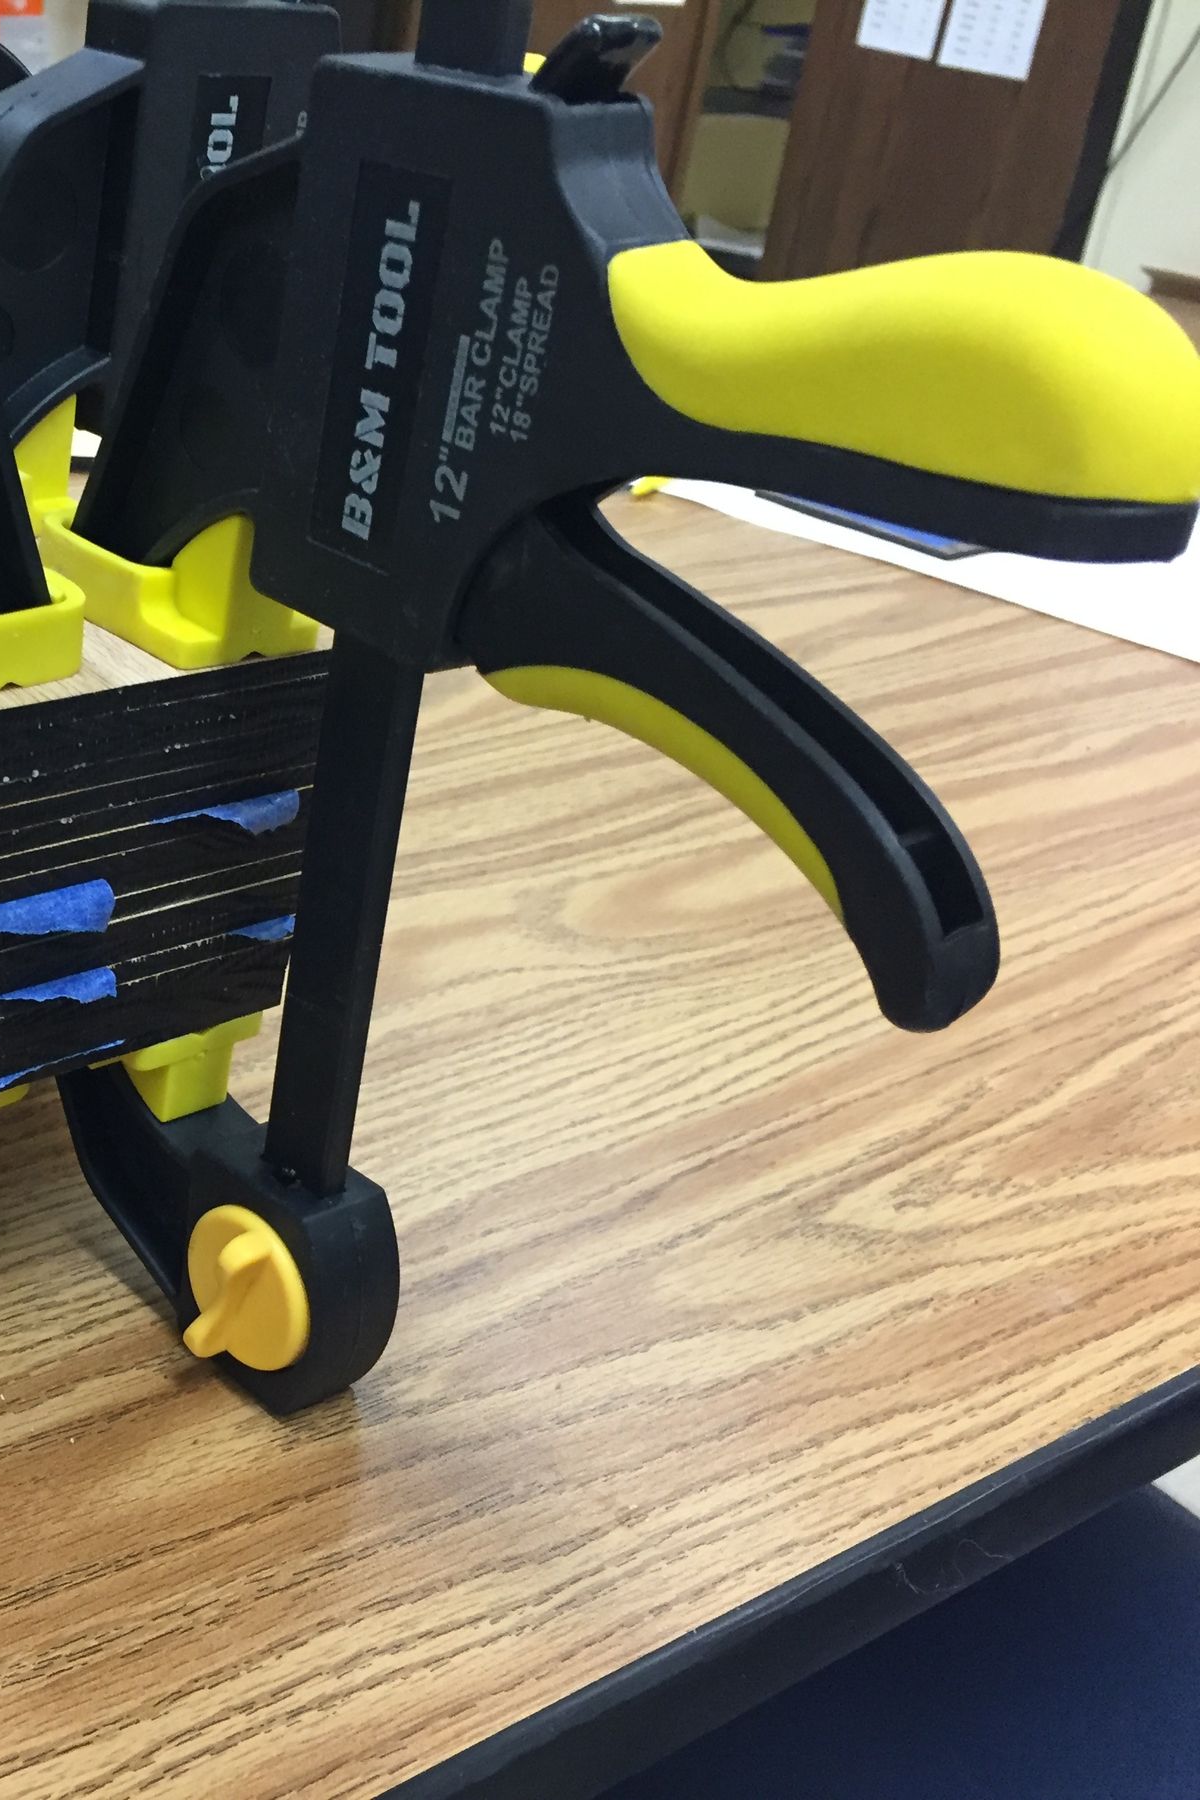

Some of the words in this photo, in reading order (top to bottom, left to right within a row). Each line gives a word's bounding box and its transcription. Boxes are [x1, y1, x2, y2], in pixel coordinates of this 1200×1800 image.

[365, 200, 421, 370] TOOL
[341, 388, 391, 542] B&M
[429, 446, 468, 523] 12"
[454, 376, 487, 451] BAR
[472, 238, 510, 367] CLAMP
